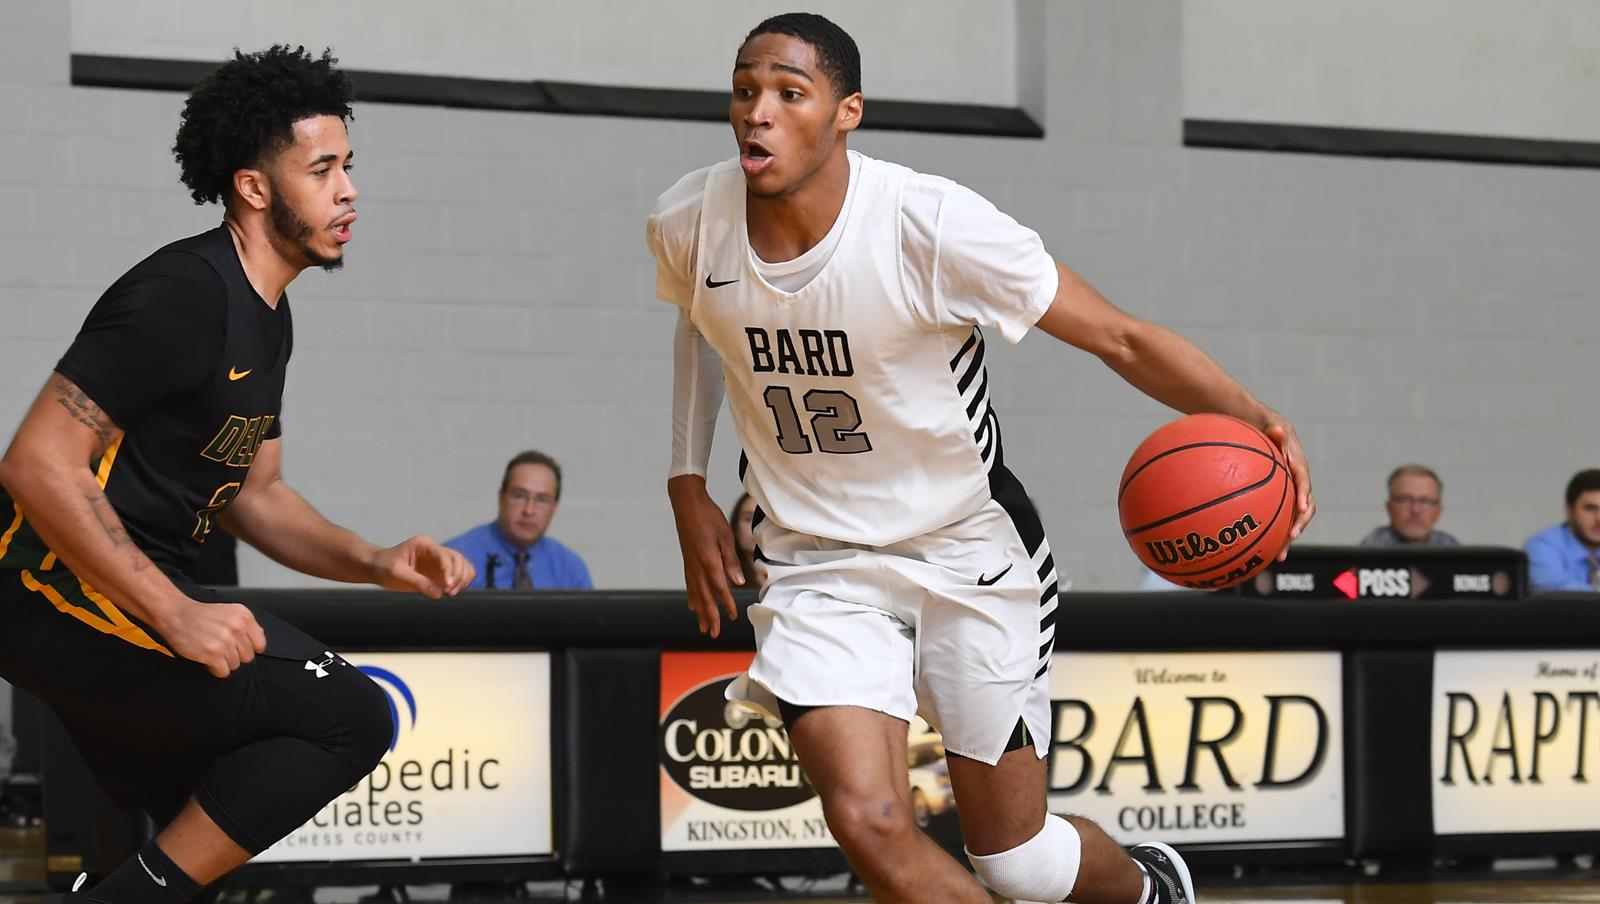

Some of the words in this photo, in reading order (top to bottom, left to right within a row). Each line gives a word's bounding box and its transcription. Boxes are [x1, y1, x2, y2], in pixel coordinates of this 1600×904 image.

[745, 327, 854, 377] BARD
[763, 385, 873, 454] 12
[1145, 513, 1259, 565] Wilson
[1276, 573, 1315, 592] BONUS
[1358, 569, 1411, 597] POSS
[1453, 574, 1492, 592] BONUS
[1134, 667, 1206, 684] Welcome
[1211, 669, 1228, 684] to
[664, 719, 799, 763] COLON
[1047, 695, 1329, 796] BARD
[346, 748, 500, 801] pedic
[689, 765, 801, 789] SUBARU
[310, 800, 423, 827] ciates
[1118, 803, 1246, 832] COLLEGE
[280, 832, 344, 848] CHESS
[354, 831, 424, 846] COUNTY
[687, 821, 797, 842] KINGSTON,
